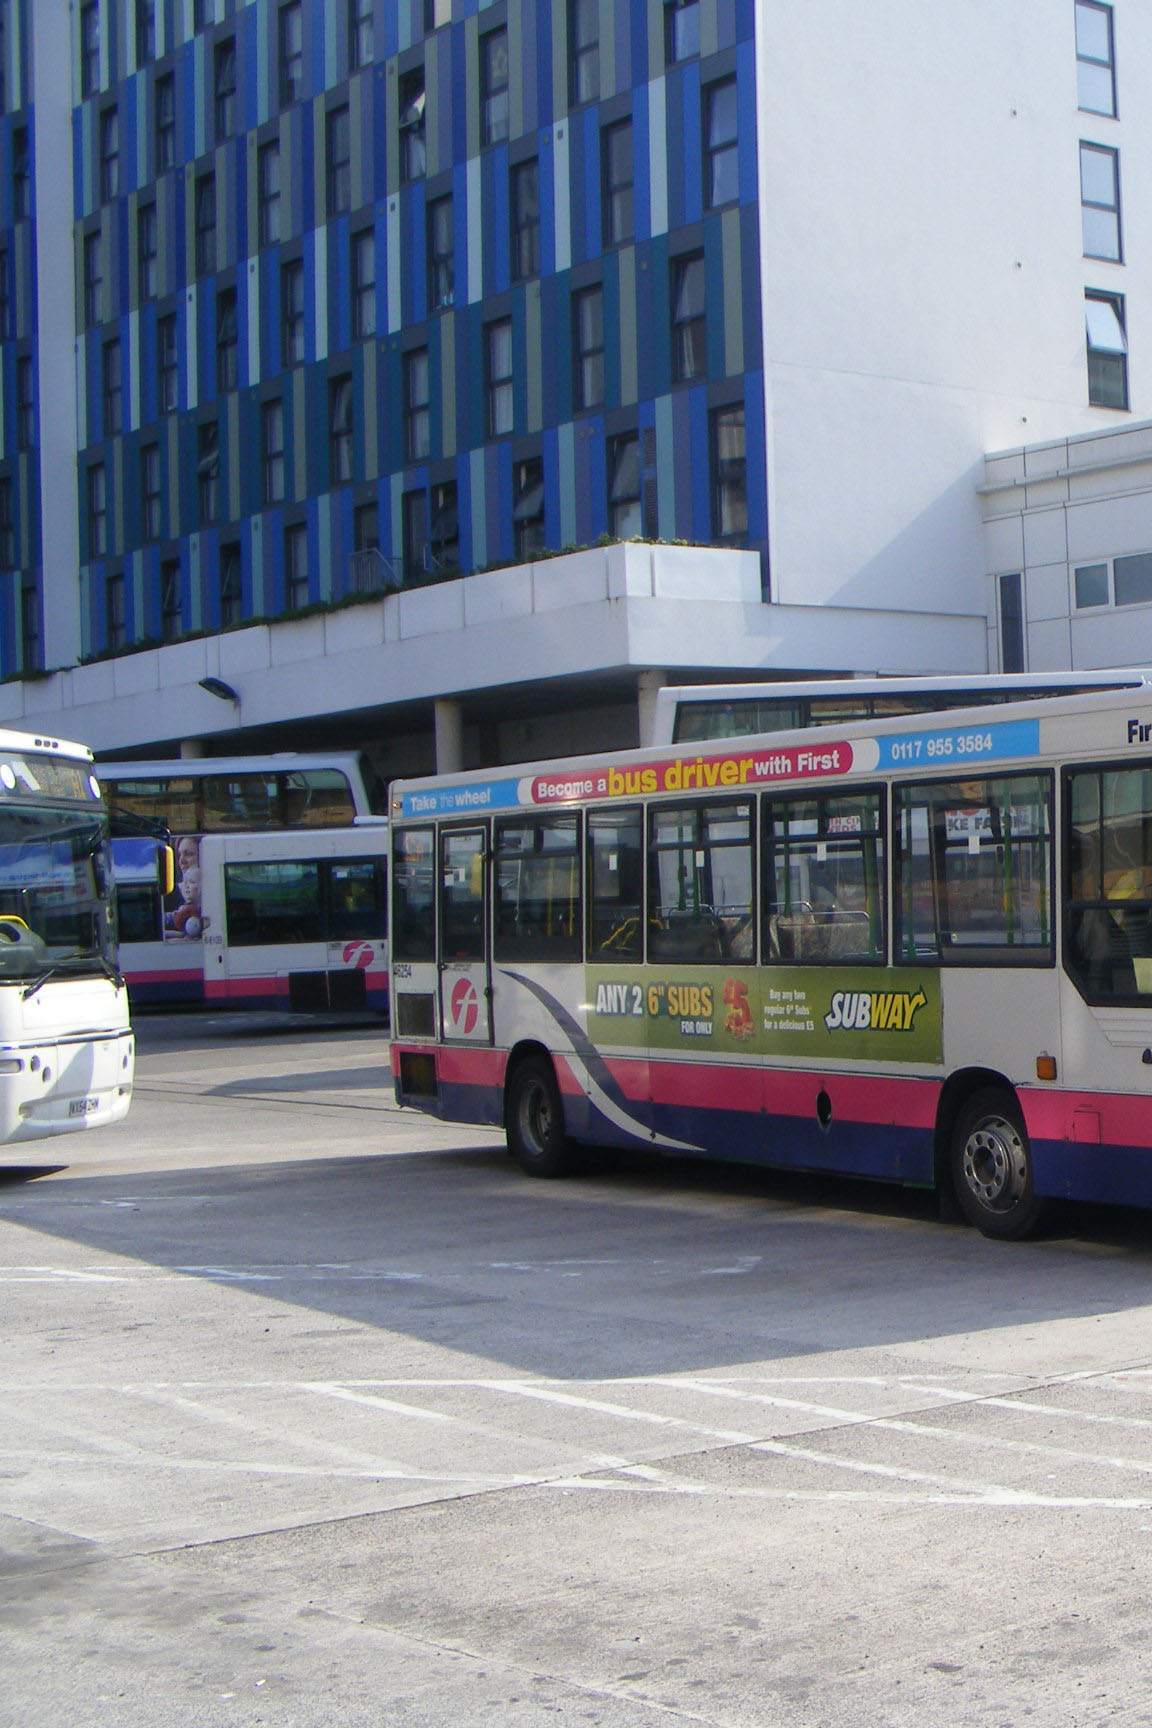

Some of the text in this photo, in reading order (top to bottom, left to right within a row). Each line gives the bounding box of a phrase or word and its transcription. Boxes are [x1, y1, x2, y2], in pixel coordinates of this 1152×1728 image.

[891, 733, 992, 760] 0117 955 3584
[538, 750, 839, 799] Become a bus driver with First
[410, 788, 491, 812] Take the wheel
[596, 984, 628, 1014] ANY
[632, 983, 643, 1014] 2
[769, 989, 806, 1001] Buy any two
[764, 1003, 785, 1016] regular
[826, 991, 927, 1030] SUBWAY
[681, 1021, 713, 1035] FOR ONLY
[764, 1019, 773, 1029] for
[779, 1020, 805, 1030] delicious
